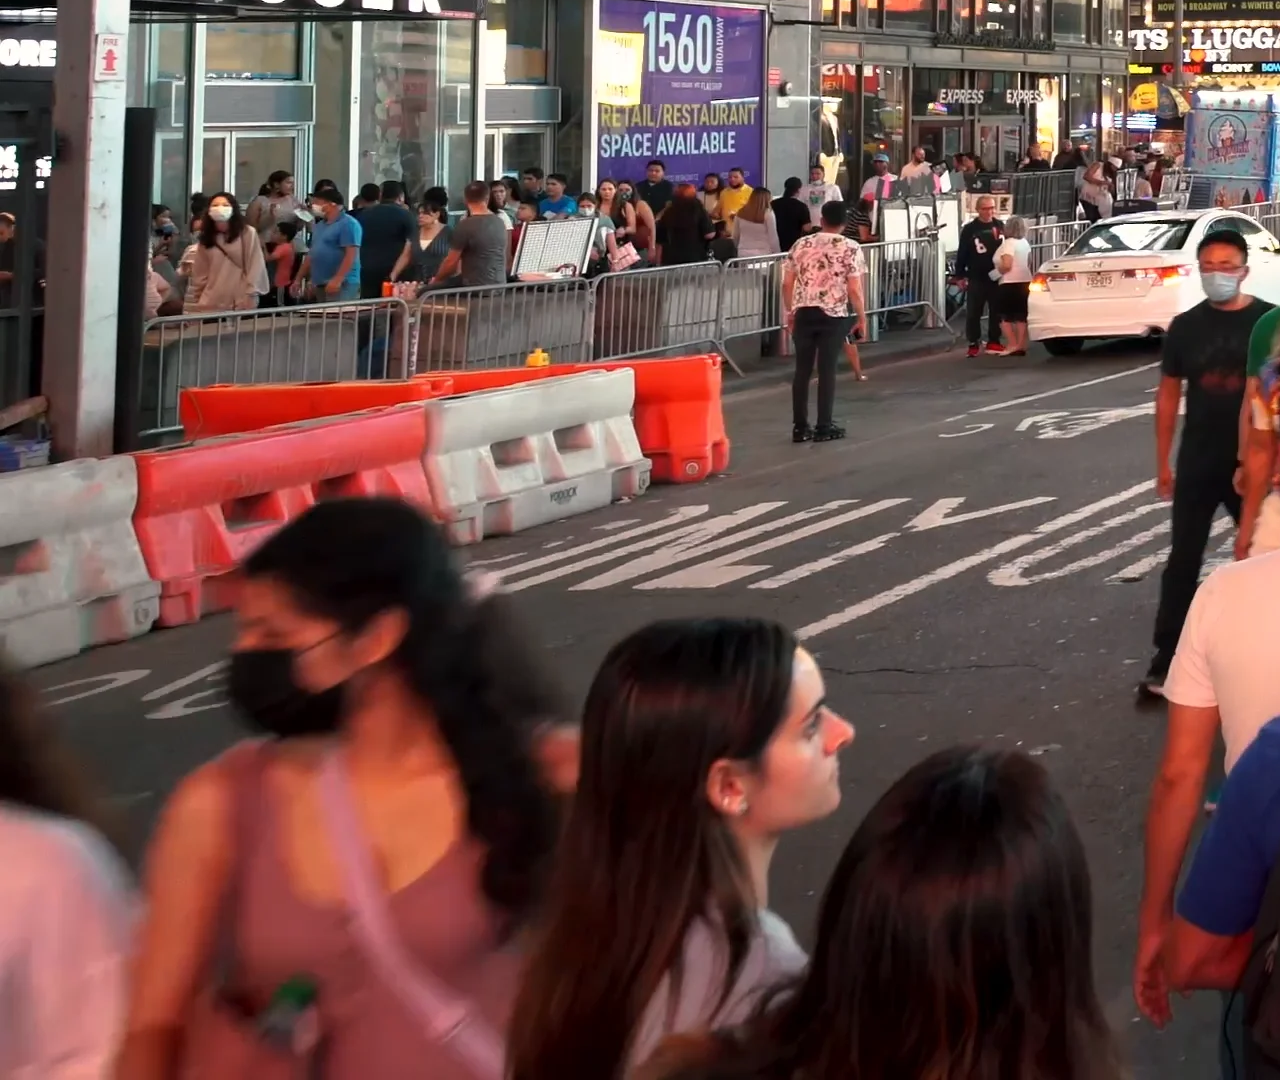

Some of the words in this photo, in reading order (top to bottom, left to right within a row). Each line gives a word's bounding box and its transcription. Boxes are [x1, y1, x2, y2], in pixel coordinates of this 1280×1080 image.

[1158, 3, 1175, 11] NOW
[1188, 2, 1227, 11] BROADWAY
[1247, 1, 1273, 10] WINTER
[103, 38, 119, 47] FIRE
[643, 10, 713, 74] 1560
[715, 17, 724, 73] BROADWAY
[1212, 63, 1254, 73] SONY
[939, 88, 984, 104] EXPRESS
[1006, 88, 1044, 104] EXPRESS
[600, 103, 757, 128] RETAIL/RESTAURANT
[600, 133, 652, 158] SPACE
[656, 131, 736, 157] AVAILABLE
[550, 487, 578, 502] YODOCK
